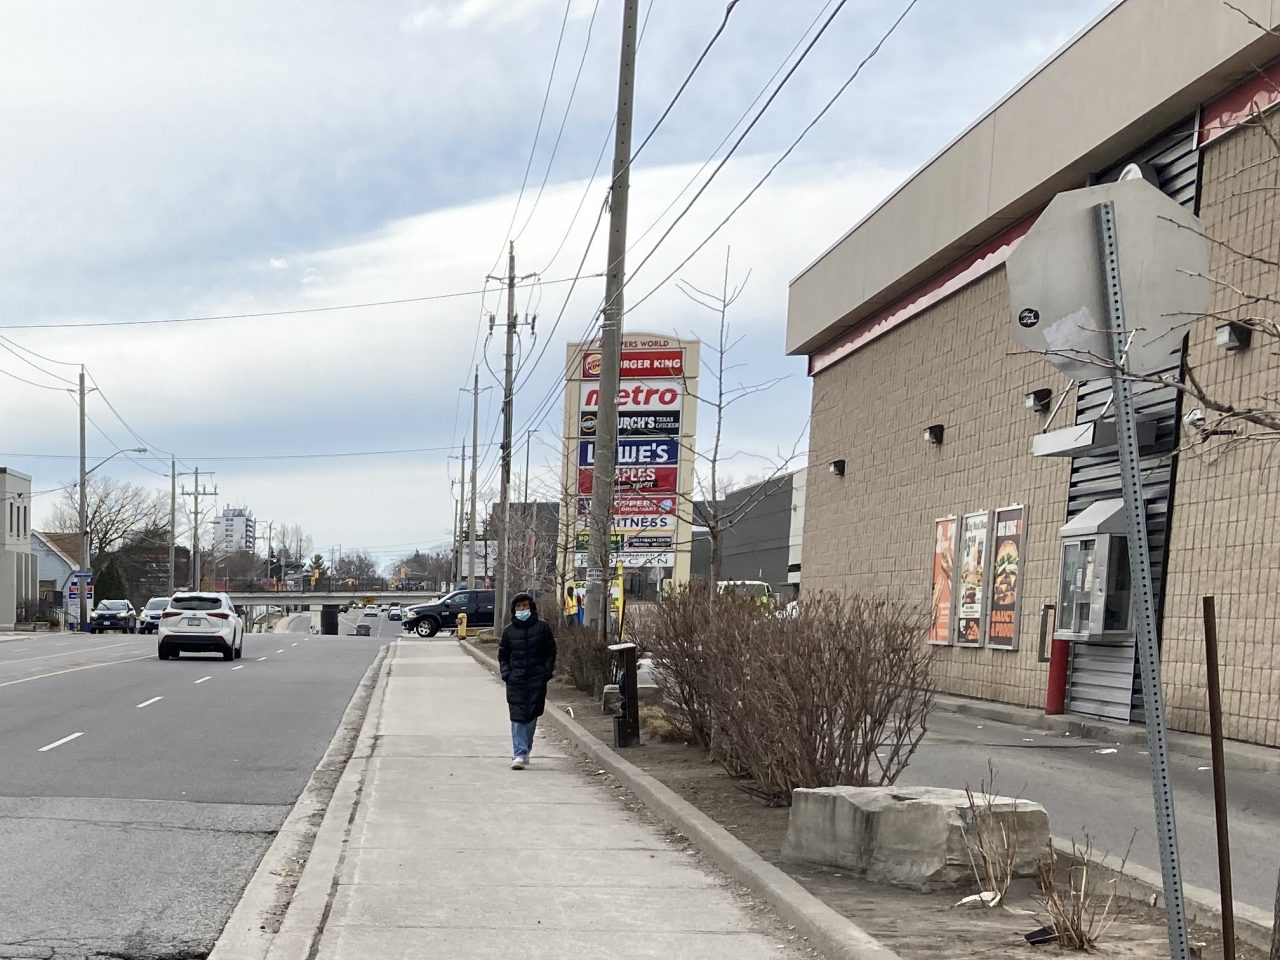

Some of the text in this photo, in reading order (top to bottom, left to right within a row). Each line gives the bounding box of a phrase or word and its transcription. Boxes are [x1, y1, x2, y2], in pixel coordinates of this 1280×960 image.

[640, 340, 669, 348] WORLD
[654, 359, 681, 368] KING
[587, 443, 668, 463] LWE'S
[617, 518, 667, 527] ITNESS
